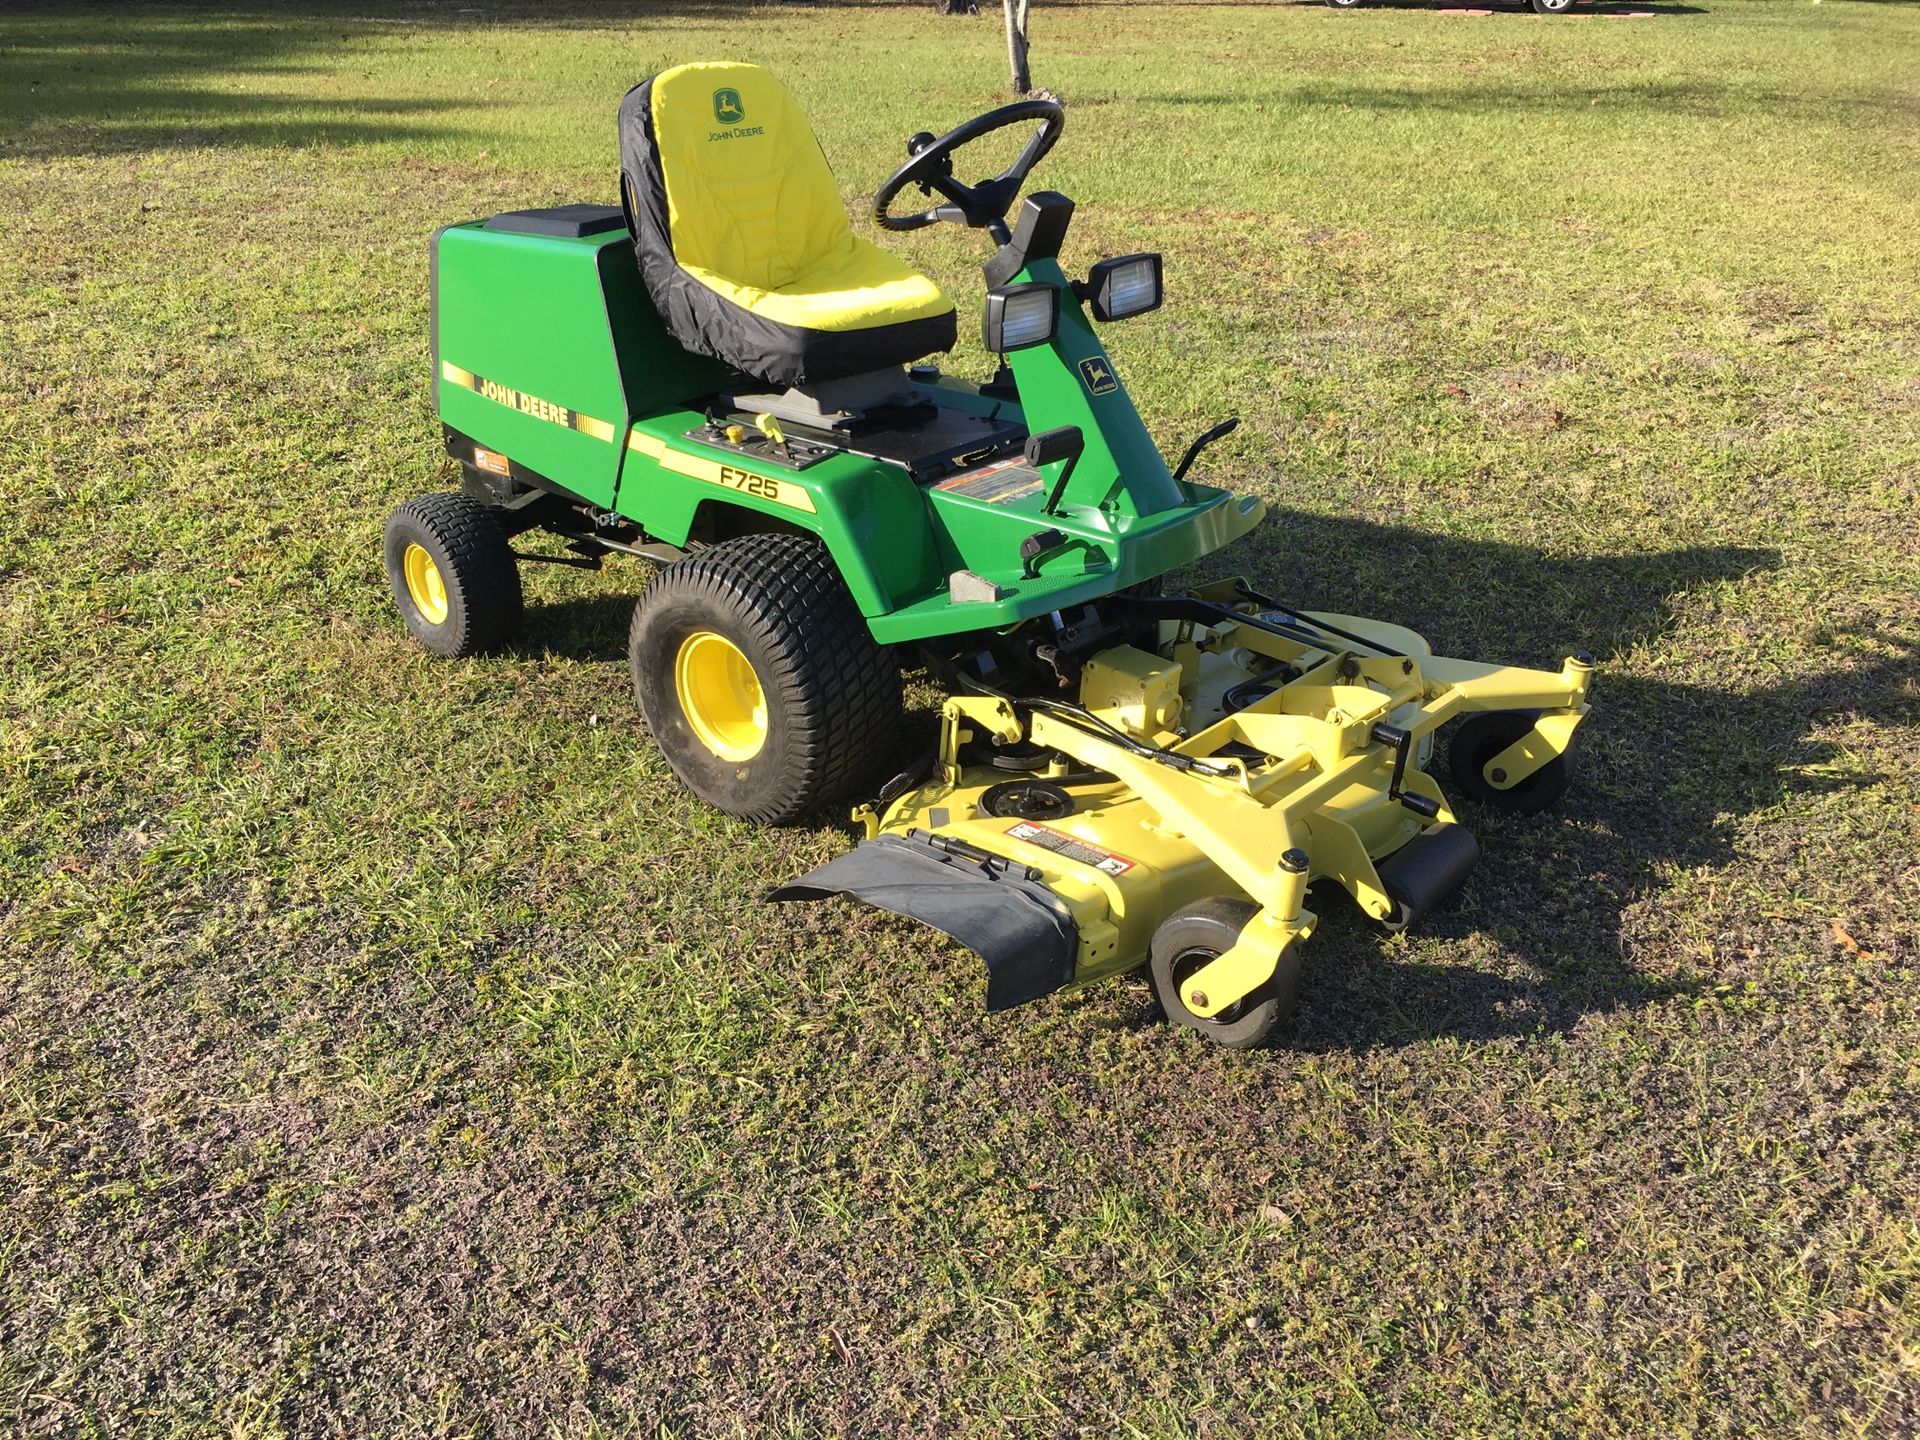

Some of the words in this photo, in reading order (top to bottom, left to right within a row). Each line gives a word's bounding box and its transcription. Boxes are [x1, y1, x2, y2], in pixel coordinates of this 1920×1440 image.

[708, 131, 733, 141] JOHN
[733, 127, 765, 138] DEERE
[480, 379, 517, 409] JOHN
[520, 391, 569, 427] DEERE
[720, 466, 779, 499] F725
